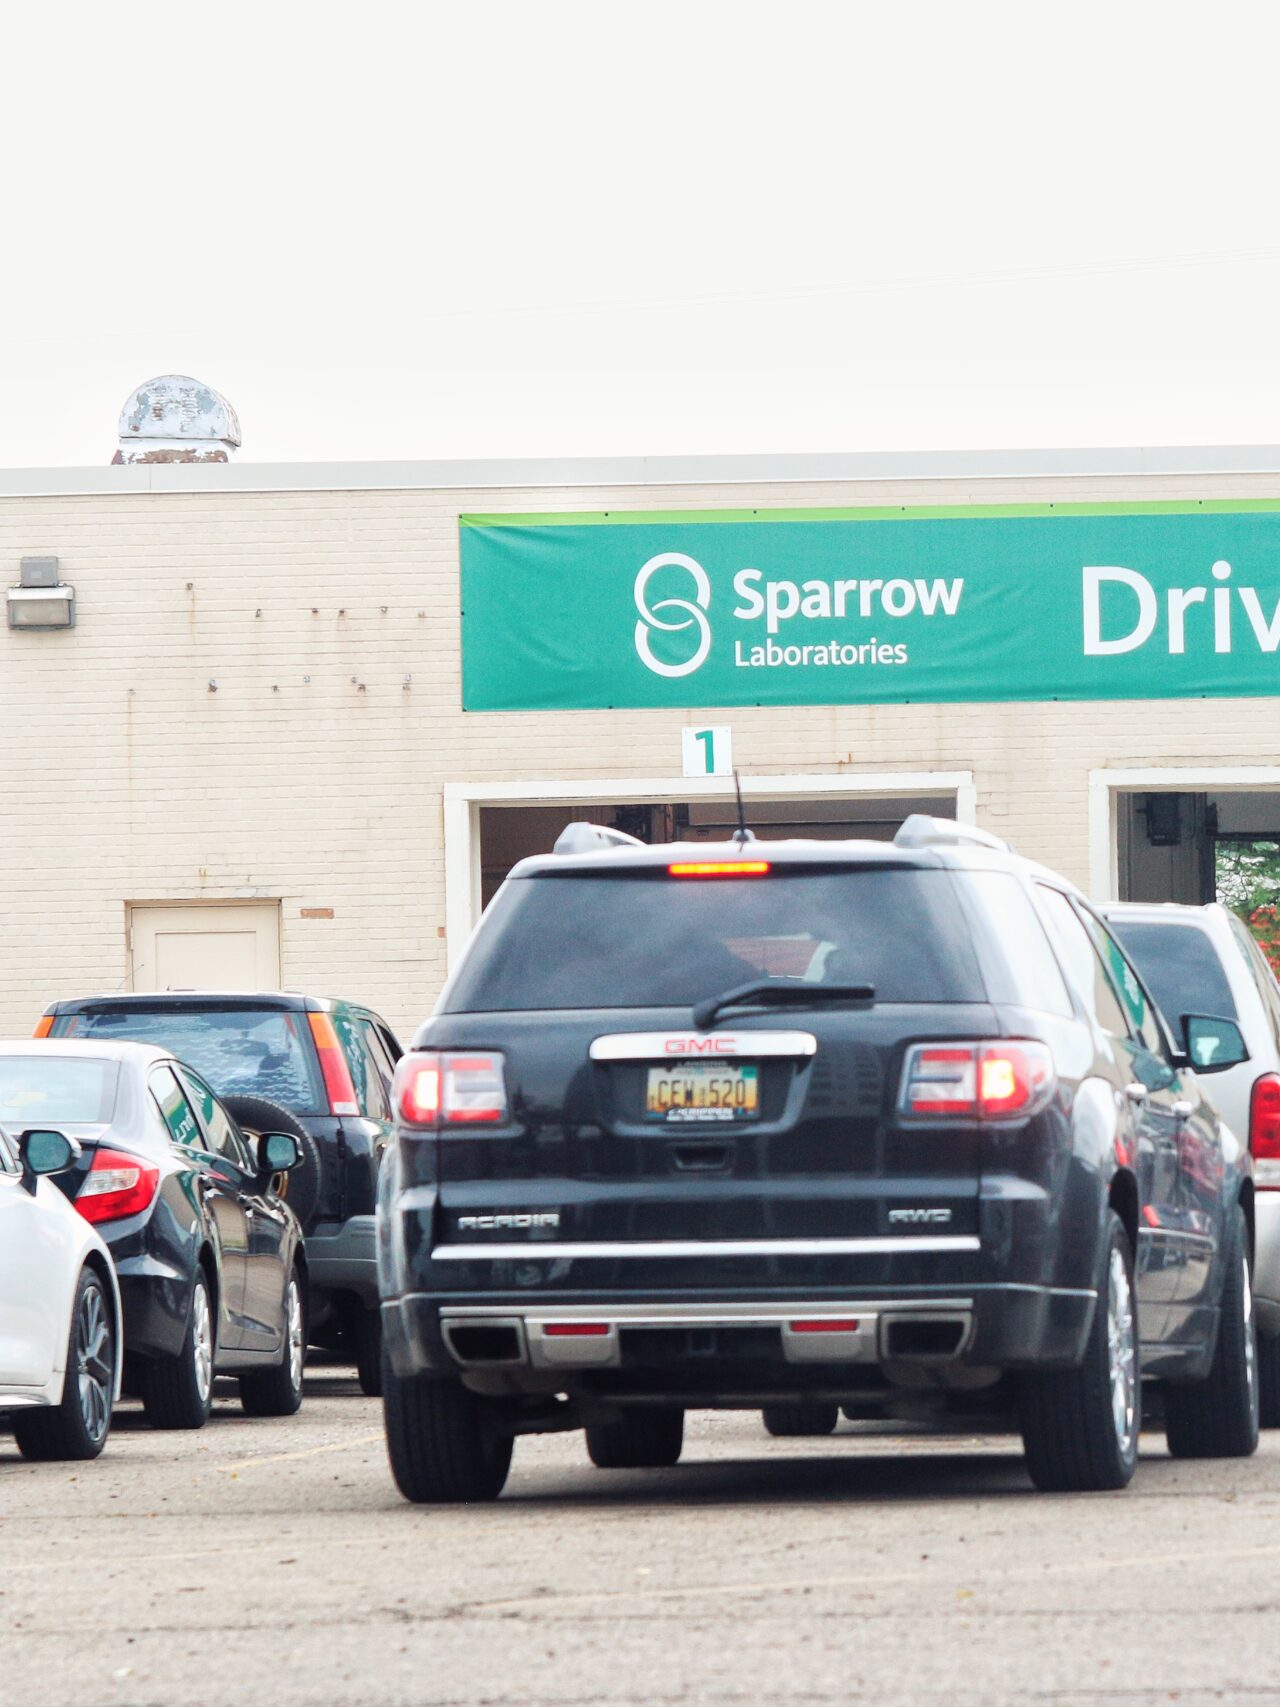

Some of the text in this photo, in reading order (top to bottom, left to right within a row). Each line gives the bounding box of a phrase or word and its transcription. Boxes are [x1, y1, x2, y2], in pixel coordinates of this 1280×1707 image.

[733, 568, 964, 634] Sparrow
[735, 637, 908, 667] Laboratories
[695, 730, 715, 774] 1
[664, 1038, 737, 1054] GMC
[709, 1079, 746, 1107] 520
[458, 1213, 560, 1231] ACADIA
